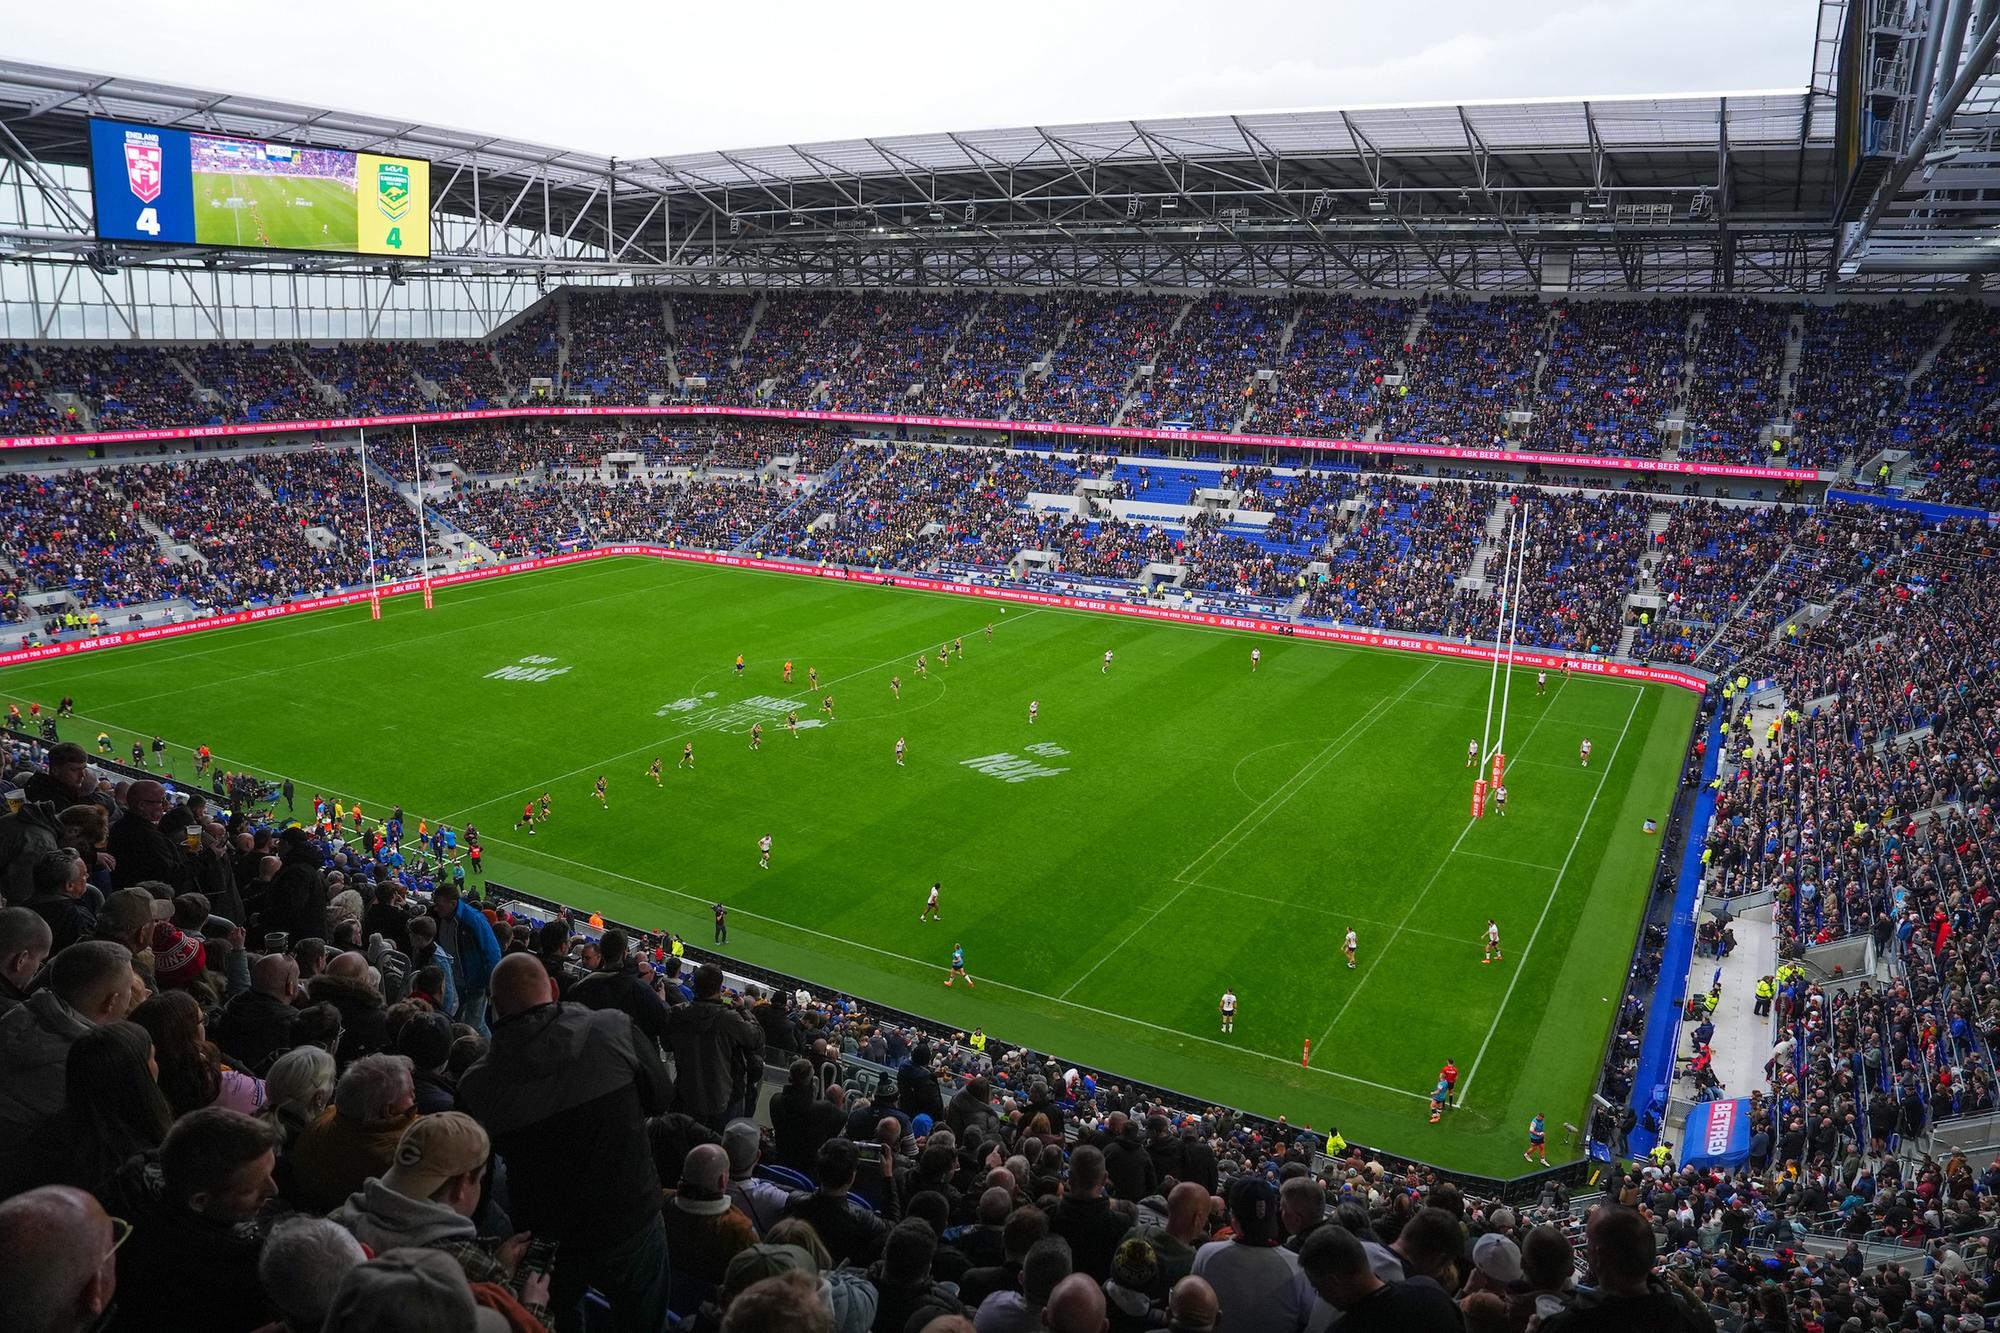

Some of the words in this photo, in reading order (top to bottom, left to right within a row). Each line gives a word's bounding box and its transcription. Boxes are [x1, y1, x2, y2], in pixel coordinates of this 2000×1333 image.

[125, 130, 159, 142] ENGLAND
[136, 207, 161, 236] 4
[386, 227, 402, 249] 4
[189, 428, 203, 436] ABK
[205, 427, 224, 435] BEER
[14, 437, 32, 447] ABK
[34, 436, 57, 445] BEER
[1301, 439, 1316, 448] ABK
[1317, 440, 1336, 449] BEER
[1461, 449, 1478, 458] ABK
[1479, 450, 1499, 460] BEER
[1637, 461, 1655, 470] ABK
[1657, 462, 1680, 471] BEER
[252, 609, 266, 619] ABK
[267, 606, 285, 616] BEER
[1220, 617, 1235, 626] ABK
[1236, 619, 1256, 628] BEER
[79, 639, 97, 649] ABK
[99, 634, 122, 646] BEER
[1382, 637, 1399, 646] ABK
[1400, 639, 1421, 649] BEER
[13, 651, 28, 660] OVER
[29, 649, 40, 657] 700
[41, 645, 61, 655] YEARS
[1581, 661, 1604, 671] BEER
[1624, 667, 1648, 676] PROUDLY
[1678, 674, 1686, 682] FOR
[1686, 677, 1697, 686] OVER
[671, 707, 778, 733] ASHES
[1707, 1103, 1733, 1156] BETFRED
[398, 1144, 422, 1168] G
